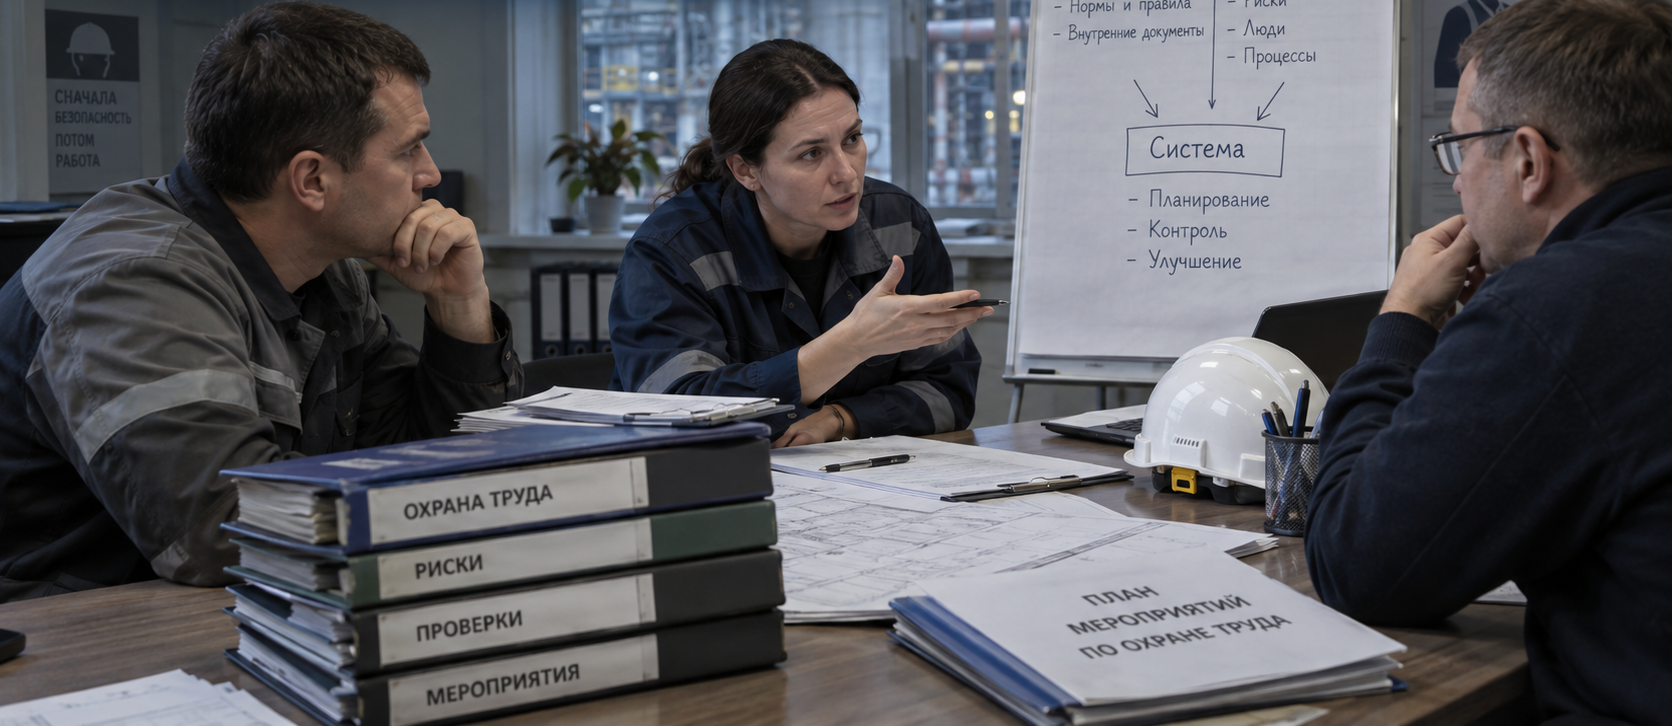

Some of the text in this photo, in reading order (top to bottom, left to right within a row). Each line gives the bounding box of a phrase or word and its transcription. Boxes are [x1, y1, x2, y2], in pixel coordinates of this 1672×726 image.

[1071, 0, 1191, 18] Нормы и правила
[1069, 24, 1204, 45] Внутренние документы
[1244, 19, 1285, 39] Люди
[1245, 47, 1315, 69] Процессы
[55, 89, 117, 104] СНАЧАЛА
[55, 111, 131, 124] БЕЗОПАСНОСТЬ
[56, 133, 94, 147] ПОТОМ
[1150, 136, 1245, 158] Система
[56, 154, 100, 167] РАБОТА
[1150, 189, 1269, 214] Планирование
[1150, 219, 1227, 245] Контроль
[1149, 250, 1241, 275] Улучшение
[404, 485, 553, 520] ОХРАНА ТРУДА
[415, 554, 482, 579] РИСКИ
[1082, 586, 1159, 606] ПЛАН
[1066, 594, 1252, 635] МЕРОПРИЯТИЙ
[416, 610, 522, 642] ПРОВЕРКИ
[1079, 614, 1292, 659] ПО ОХРАНЕ ТРУДА
[426, 663, 580, 706] МЕРОПРИЯТИЯ
